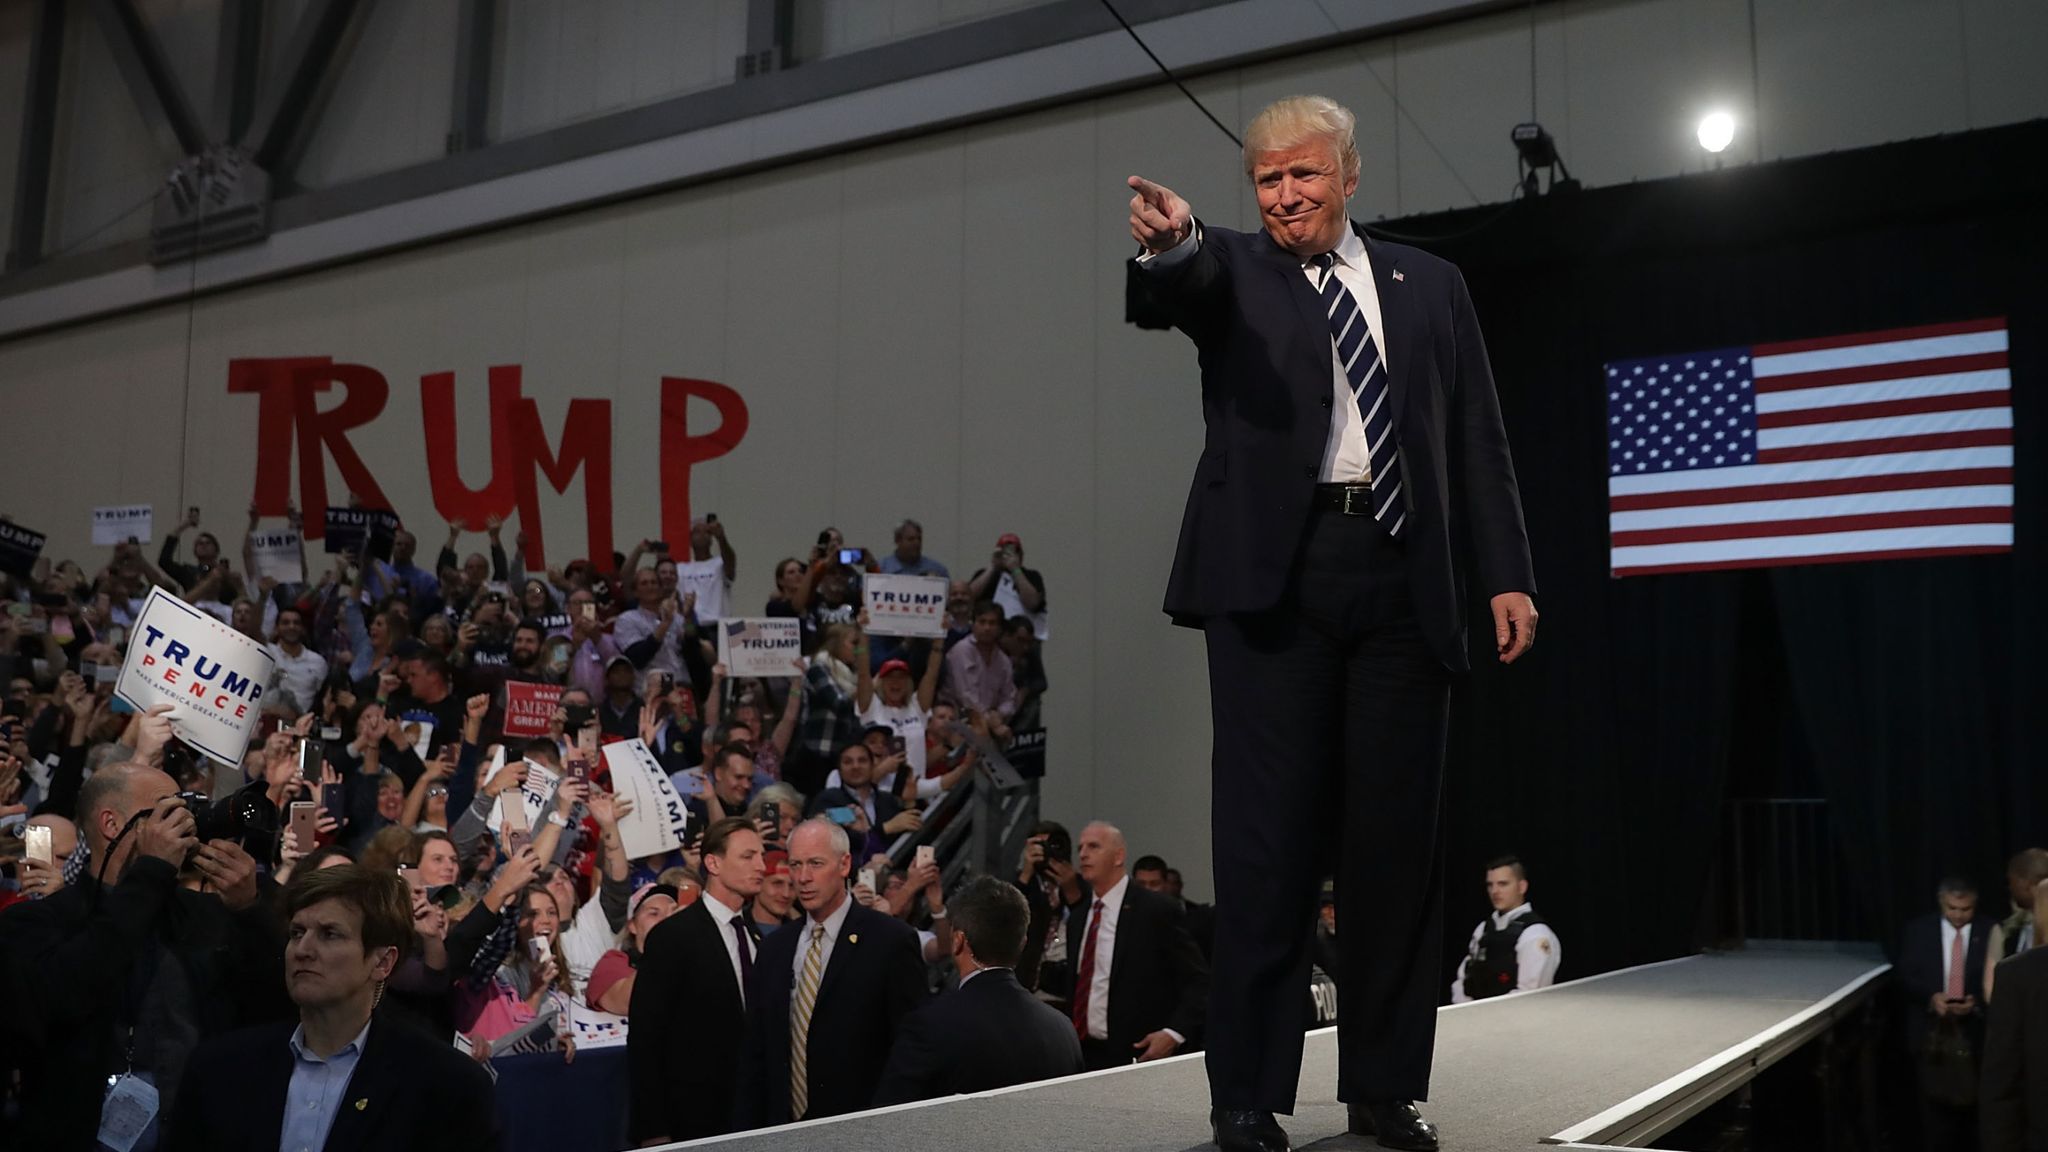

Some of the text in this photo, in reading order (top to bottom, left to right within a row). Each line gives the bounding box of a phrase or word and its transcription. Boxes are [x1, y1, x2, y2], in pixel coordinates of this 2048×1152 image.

[228, 356, 749, 572] TRUMP
[0, 526, 44, 547] UMP
[256, 535, 296, 548] UMP
[871, 591, 943, 605] TRUMP
[876, 604, 936, 614] PENCE
[742, 639, 799, 649] TRUMP
[145, 625, 263, 702] TRUMP
[136, 669, 153, 684] MAKE
[153, 683, 190, 706] AMERICA
[192, 704, 217, 719] GREAT
[142, 654, 248, 719] PENCE
[512, 699, 557, 716] AMER
[513, 715, 546, 727] GREAT
[635, 741, 687, 843] TRUMP
